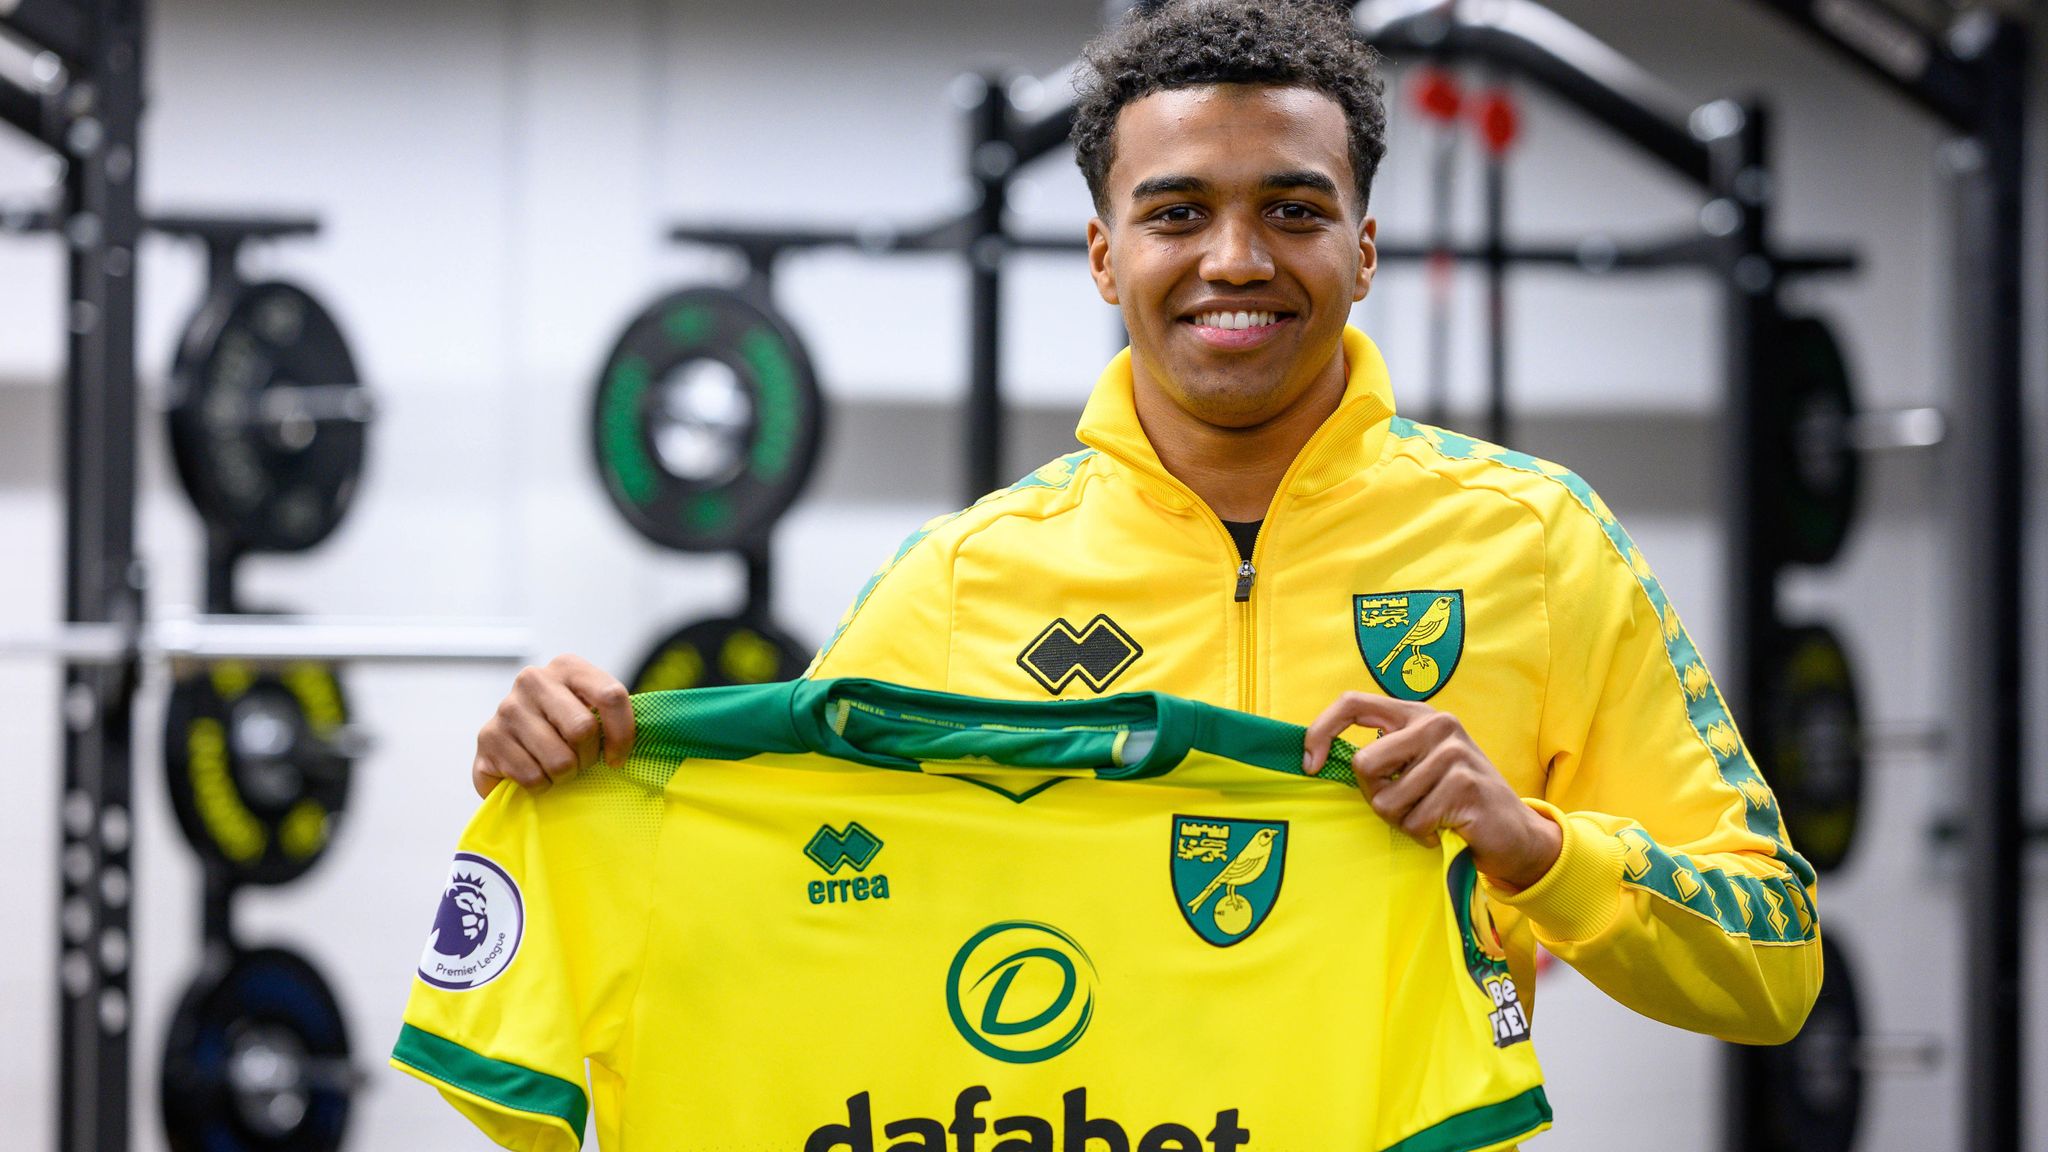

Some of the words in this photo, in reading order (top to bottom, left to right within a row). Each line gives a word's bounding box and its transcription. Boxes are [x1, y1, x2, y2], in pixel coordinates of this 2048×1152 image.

[807, 873, 890, 905] errea
[435, 962, 477, 976] Premier
[477, 932, 506, 969] League
